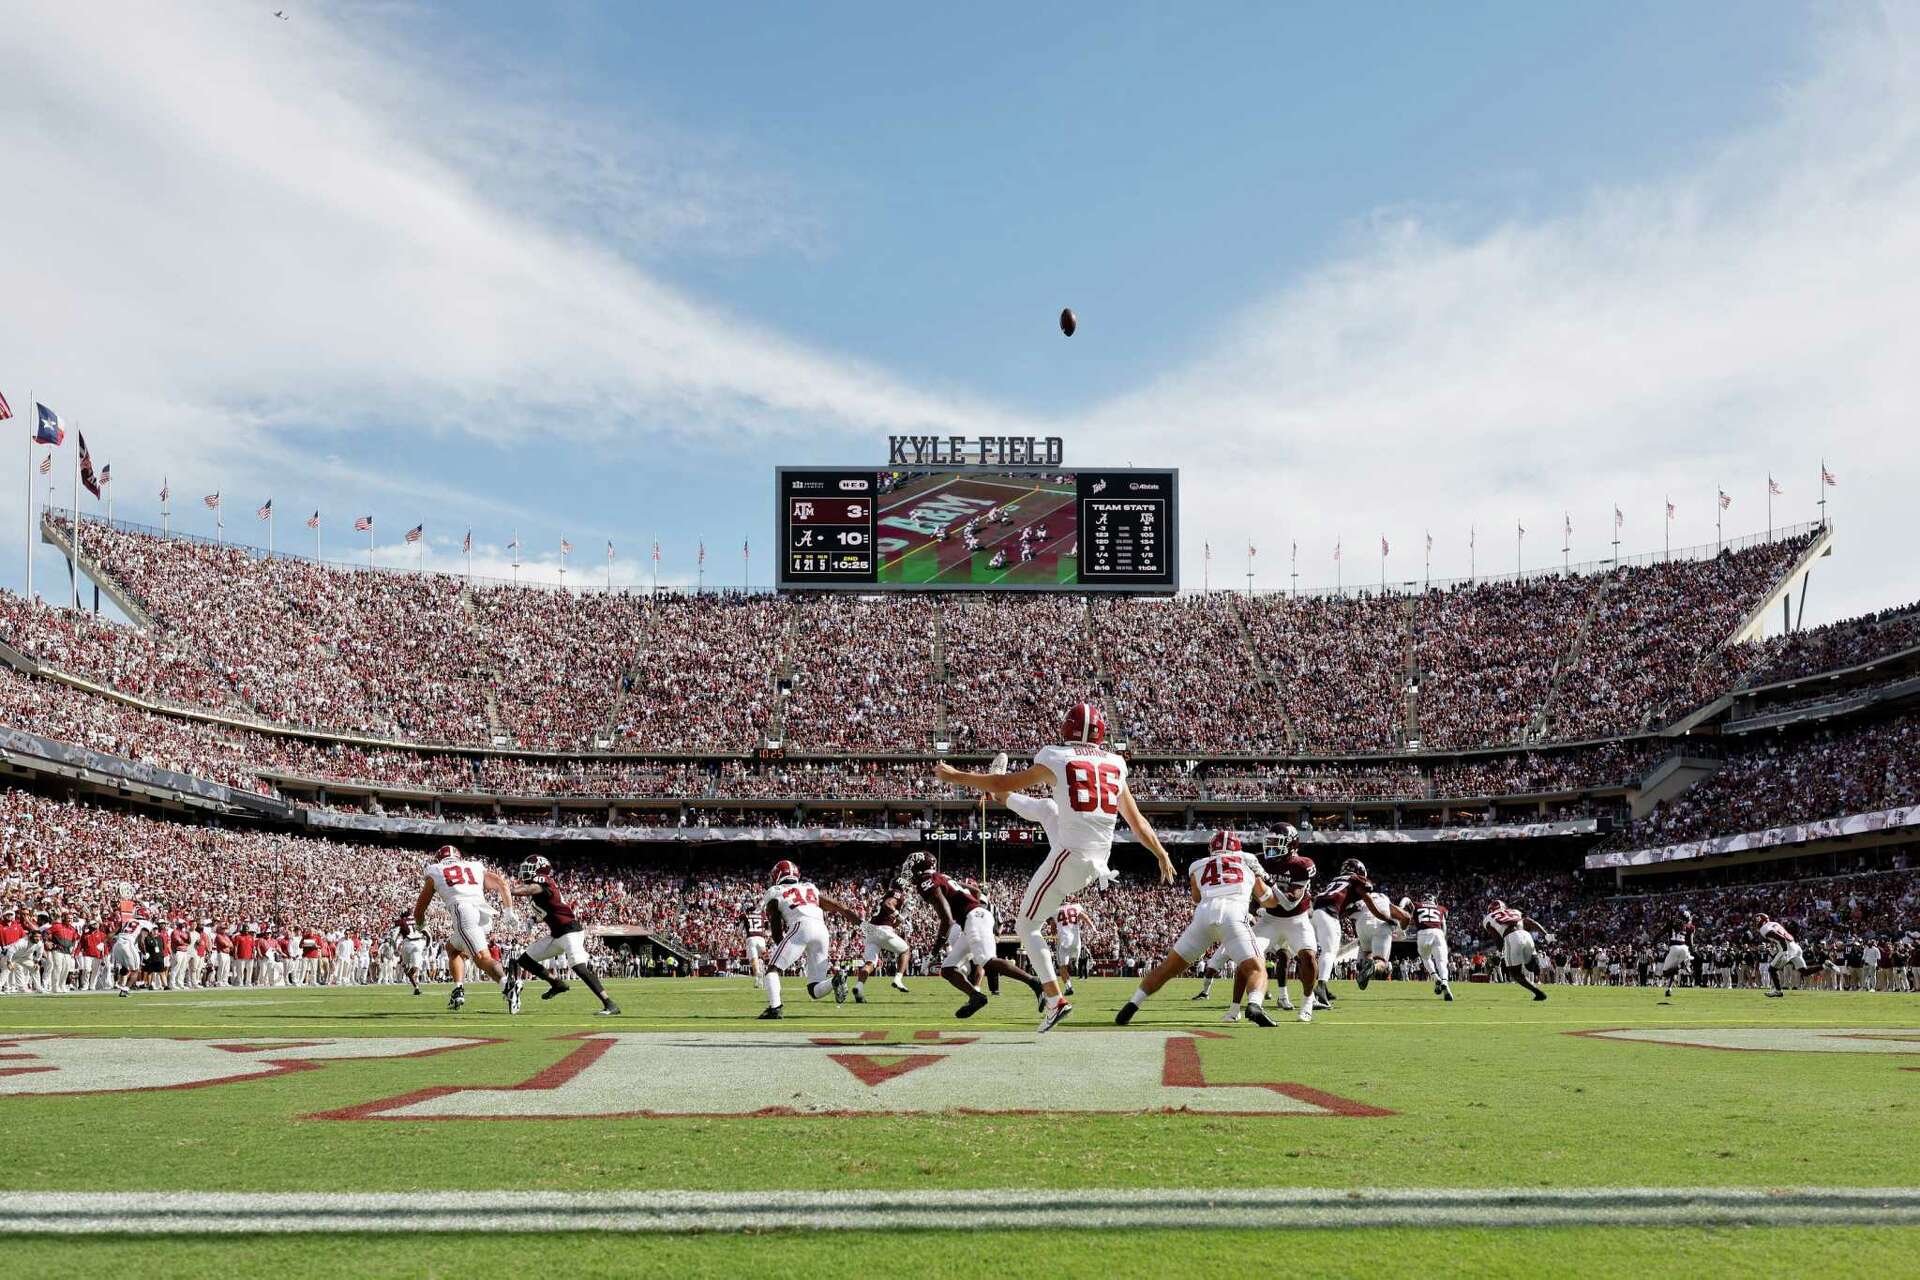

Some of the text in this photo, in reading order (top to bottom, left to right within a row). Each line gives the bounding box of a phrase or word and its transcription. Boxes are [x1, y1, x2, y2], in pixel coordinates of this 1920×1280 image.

[889, 436, 1063, 465] KYLE FIELD
[847, 505, 862, 518] 3
[837, 532, 862, 546] 10
[795, 559, 826, 571] 4 21 5
[832, 561, 869, 569] 10:25
[1065, 760, 1121, 815] 86
[443, 864, 479, 888] 81
[1200, 856, 1244, 887] 45
[1057, 907, 1078, 926] 48
[1416, 907, 1441, 923] 25
[747, 918, 763, 933] 12
